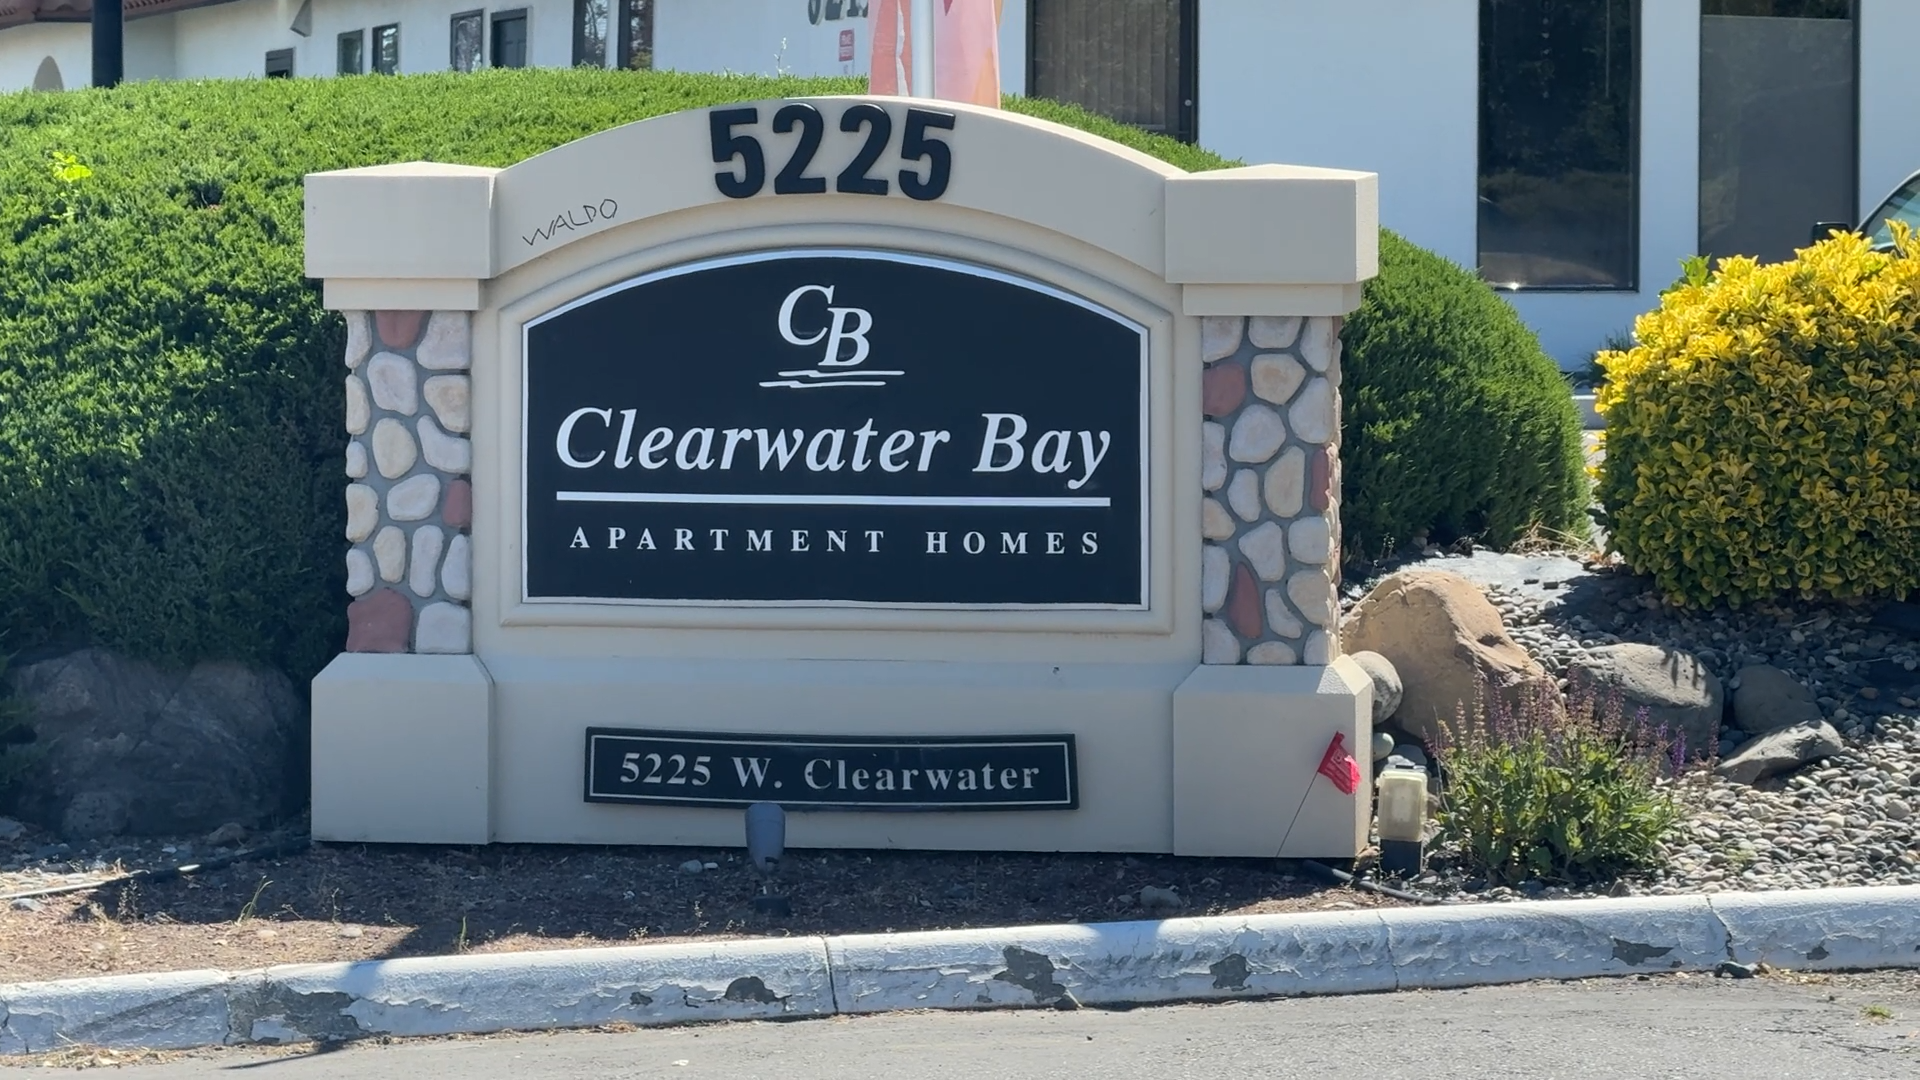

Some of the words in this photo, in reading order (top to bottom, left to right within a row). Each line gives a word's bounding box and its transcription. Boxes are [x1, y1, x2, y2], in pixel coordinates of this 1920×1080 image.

[709, 102, 956, 201] 5225
[522, 198, 618, 246] WALDO
[778, 284, 873, 366] CB
[556, 407, 951, 472] Clearwater
[972, 413, 1111, 490] Bay
[569, 526, 884, 553] APARTMENT
[925, 531, 1098, 555] HOMES
[619, 752, 712, 786] 5225
[731, 757, 783, 789] W.
[804, 758, 1040, 791] Clearwater
